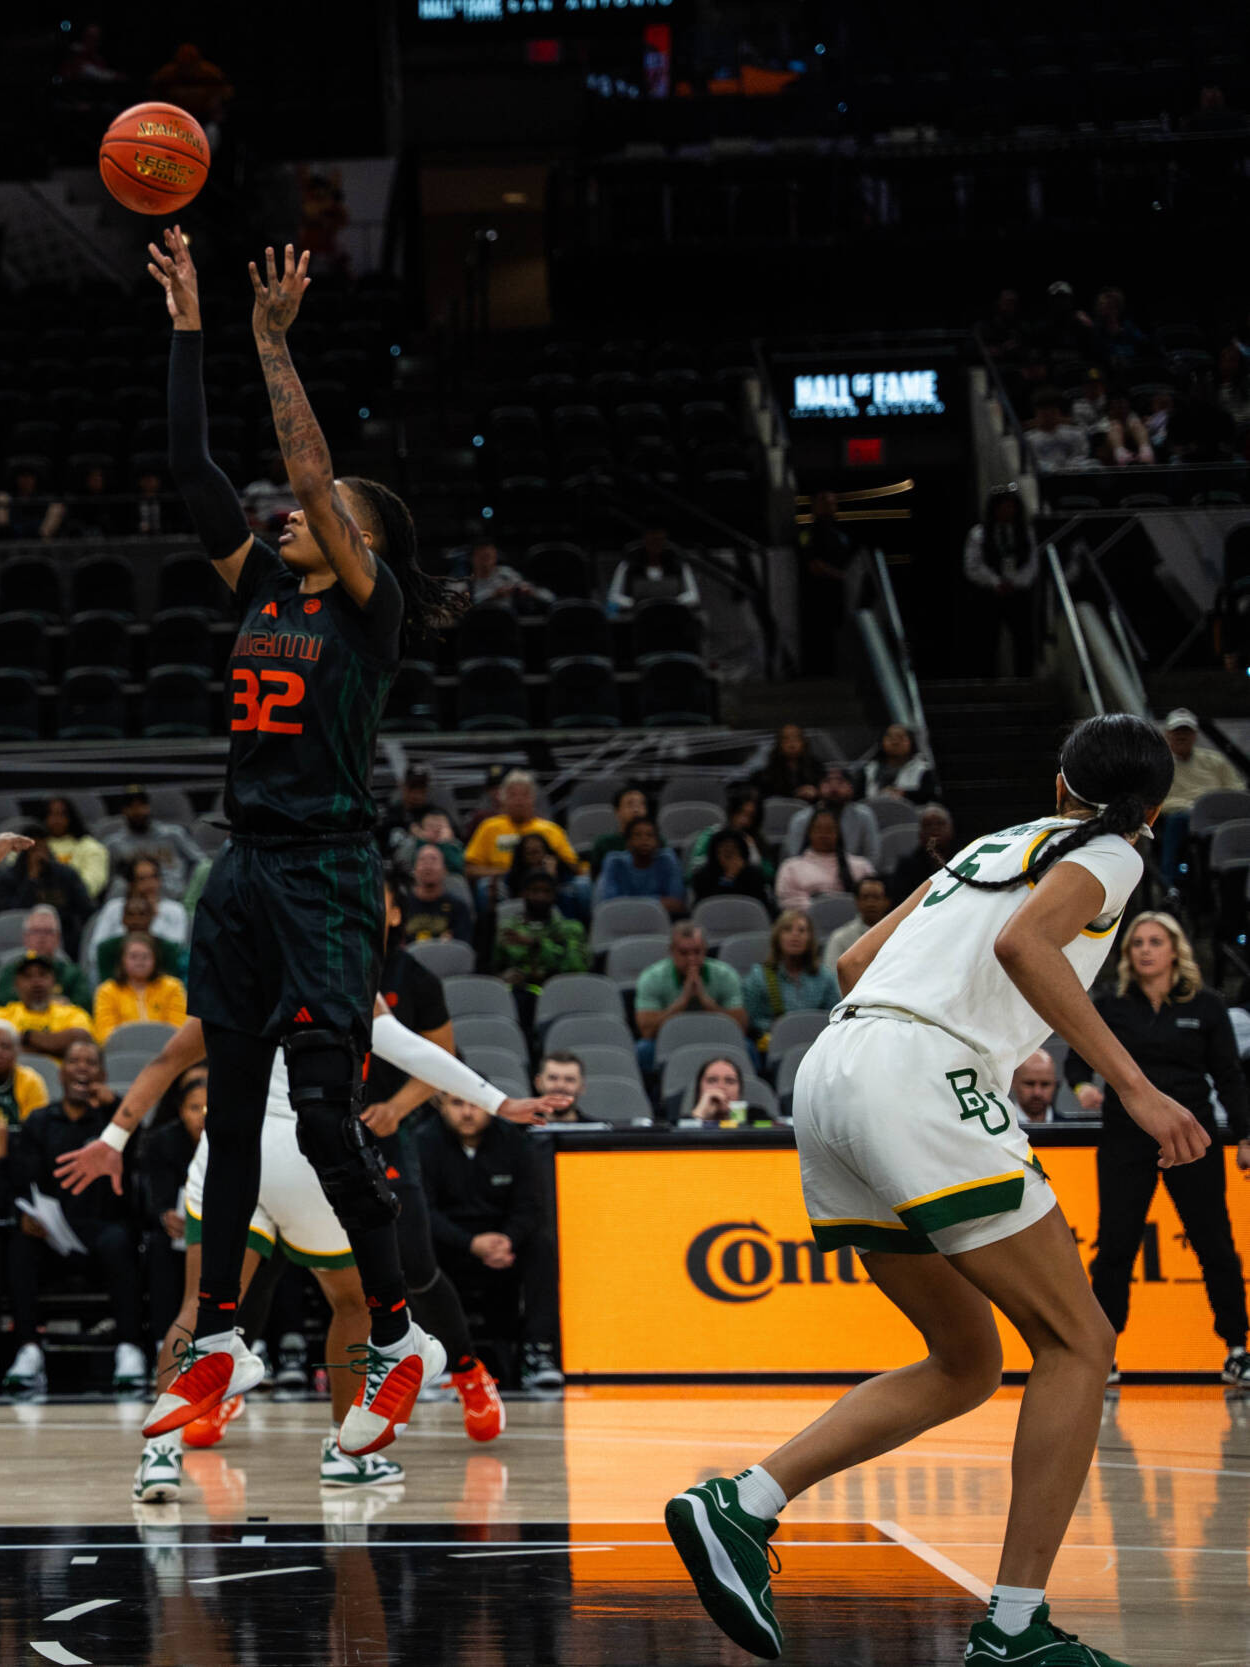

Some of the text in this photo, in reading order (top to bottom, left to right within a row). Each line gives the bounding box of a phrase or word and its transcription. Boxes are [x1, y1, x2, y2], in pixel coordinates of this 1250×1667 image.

[794, 374, 855, 411] HALL
[872, 369, 938, 404] FAME
[230, 667, 306, 735] 32
[945, 1067, 1010, 1136] BU
